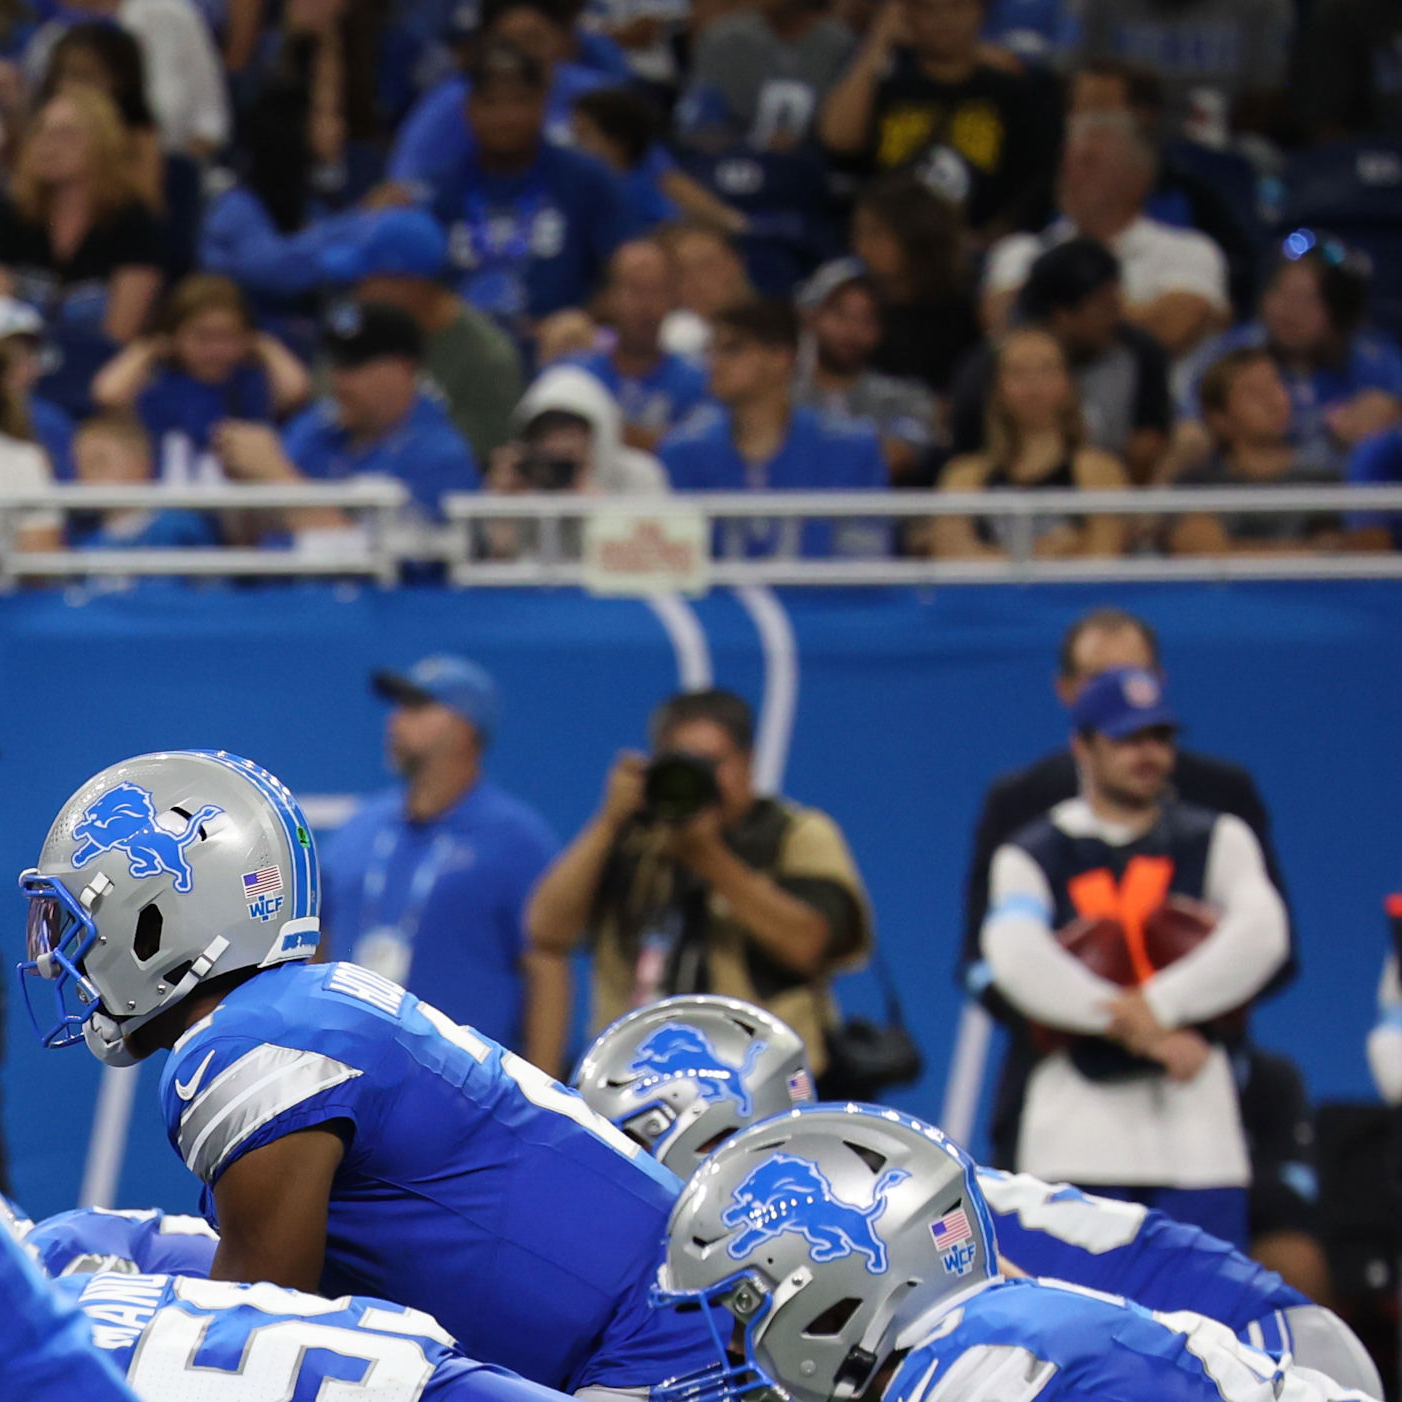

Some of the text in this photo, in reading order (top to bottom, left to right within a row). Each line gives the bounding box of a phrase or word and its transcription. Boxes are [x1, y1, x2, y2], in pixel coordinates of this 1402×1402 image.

[249, 896, 284, 921] WCF
[943, 1243, 975, 1274] WCF
[78, 1272, 168, 1349] MANU
